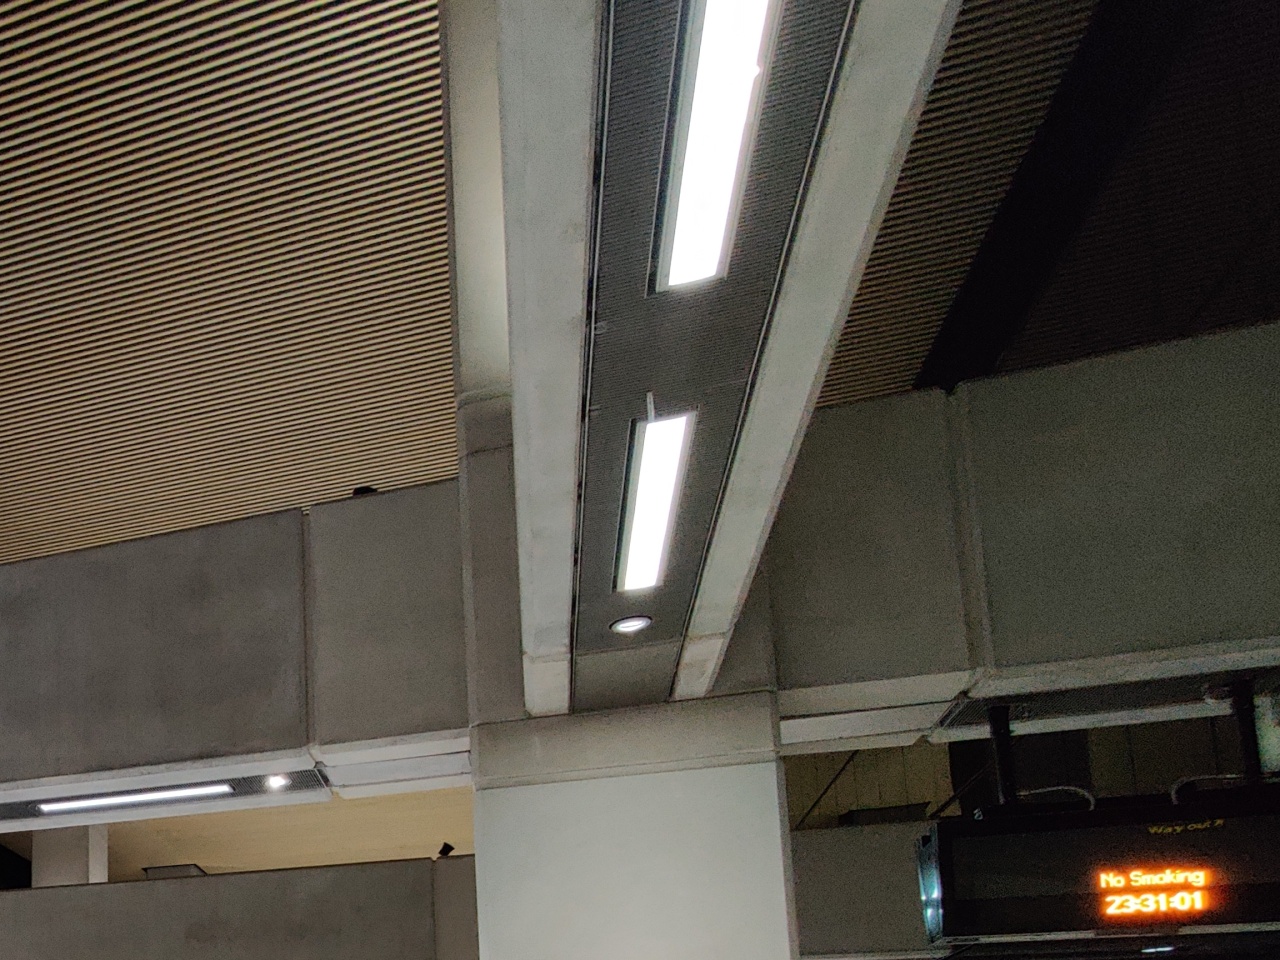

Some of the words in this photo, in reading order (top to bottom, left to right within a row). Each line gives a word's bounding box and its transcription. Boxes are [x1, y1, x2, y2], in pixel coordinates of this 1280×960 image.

[1100, 872, 1126, 888] No
[1129, 869, 1206, 887] Smoking
[1104, 891, 1204, 915] 23:31:01
